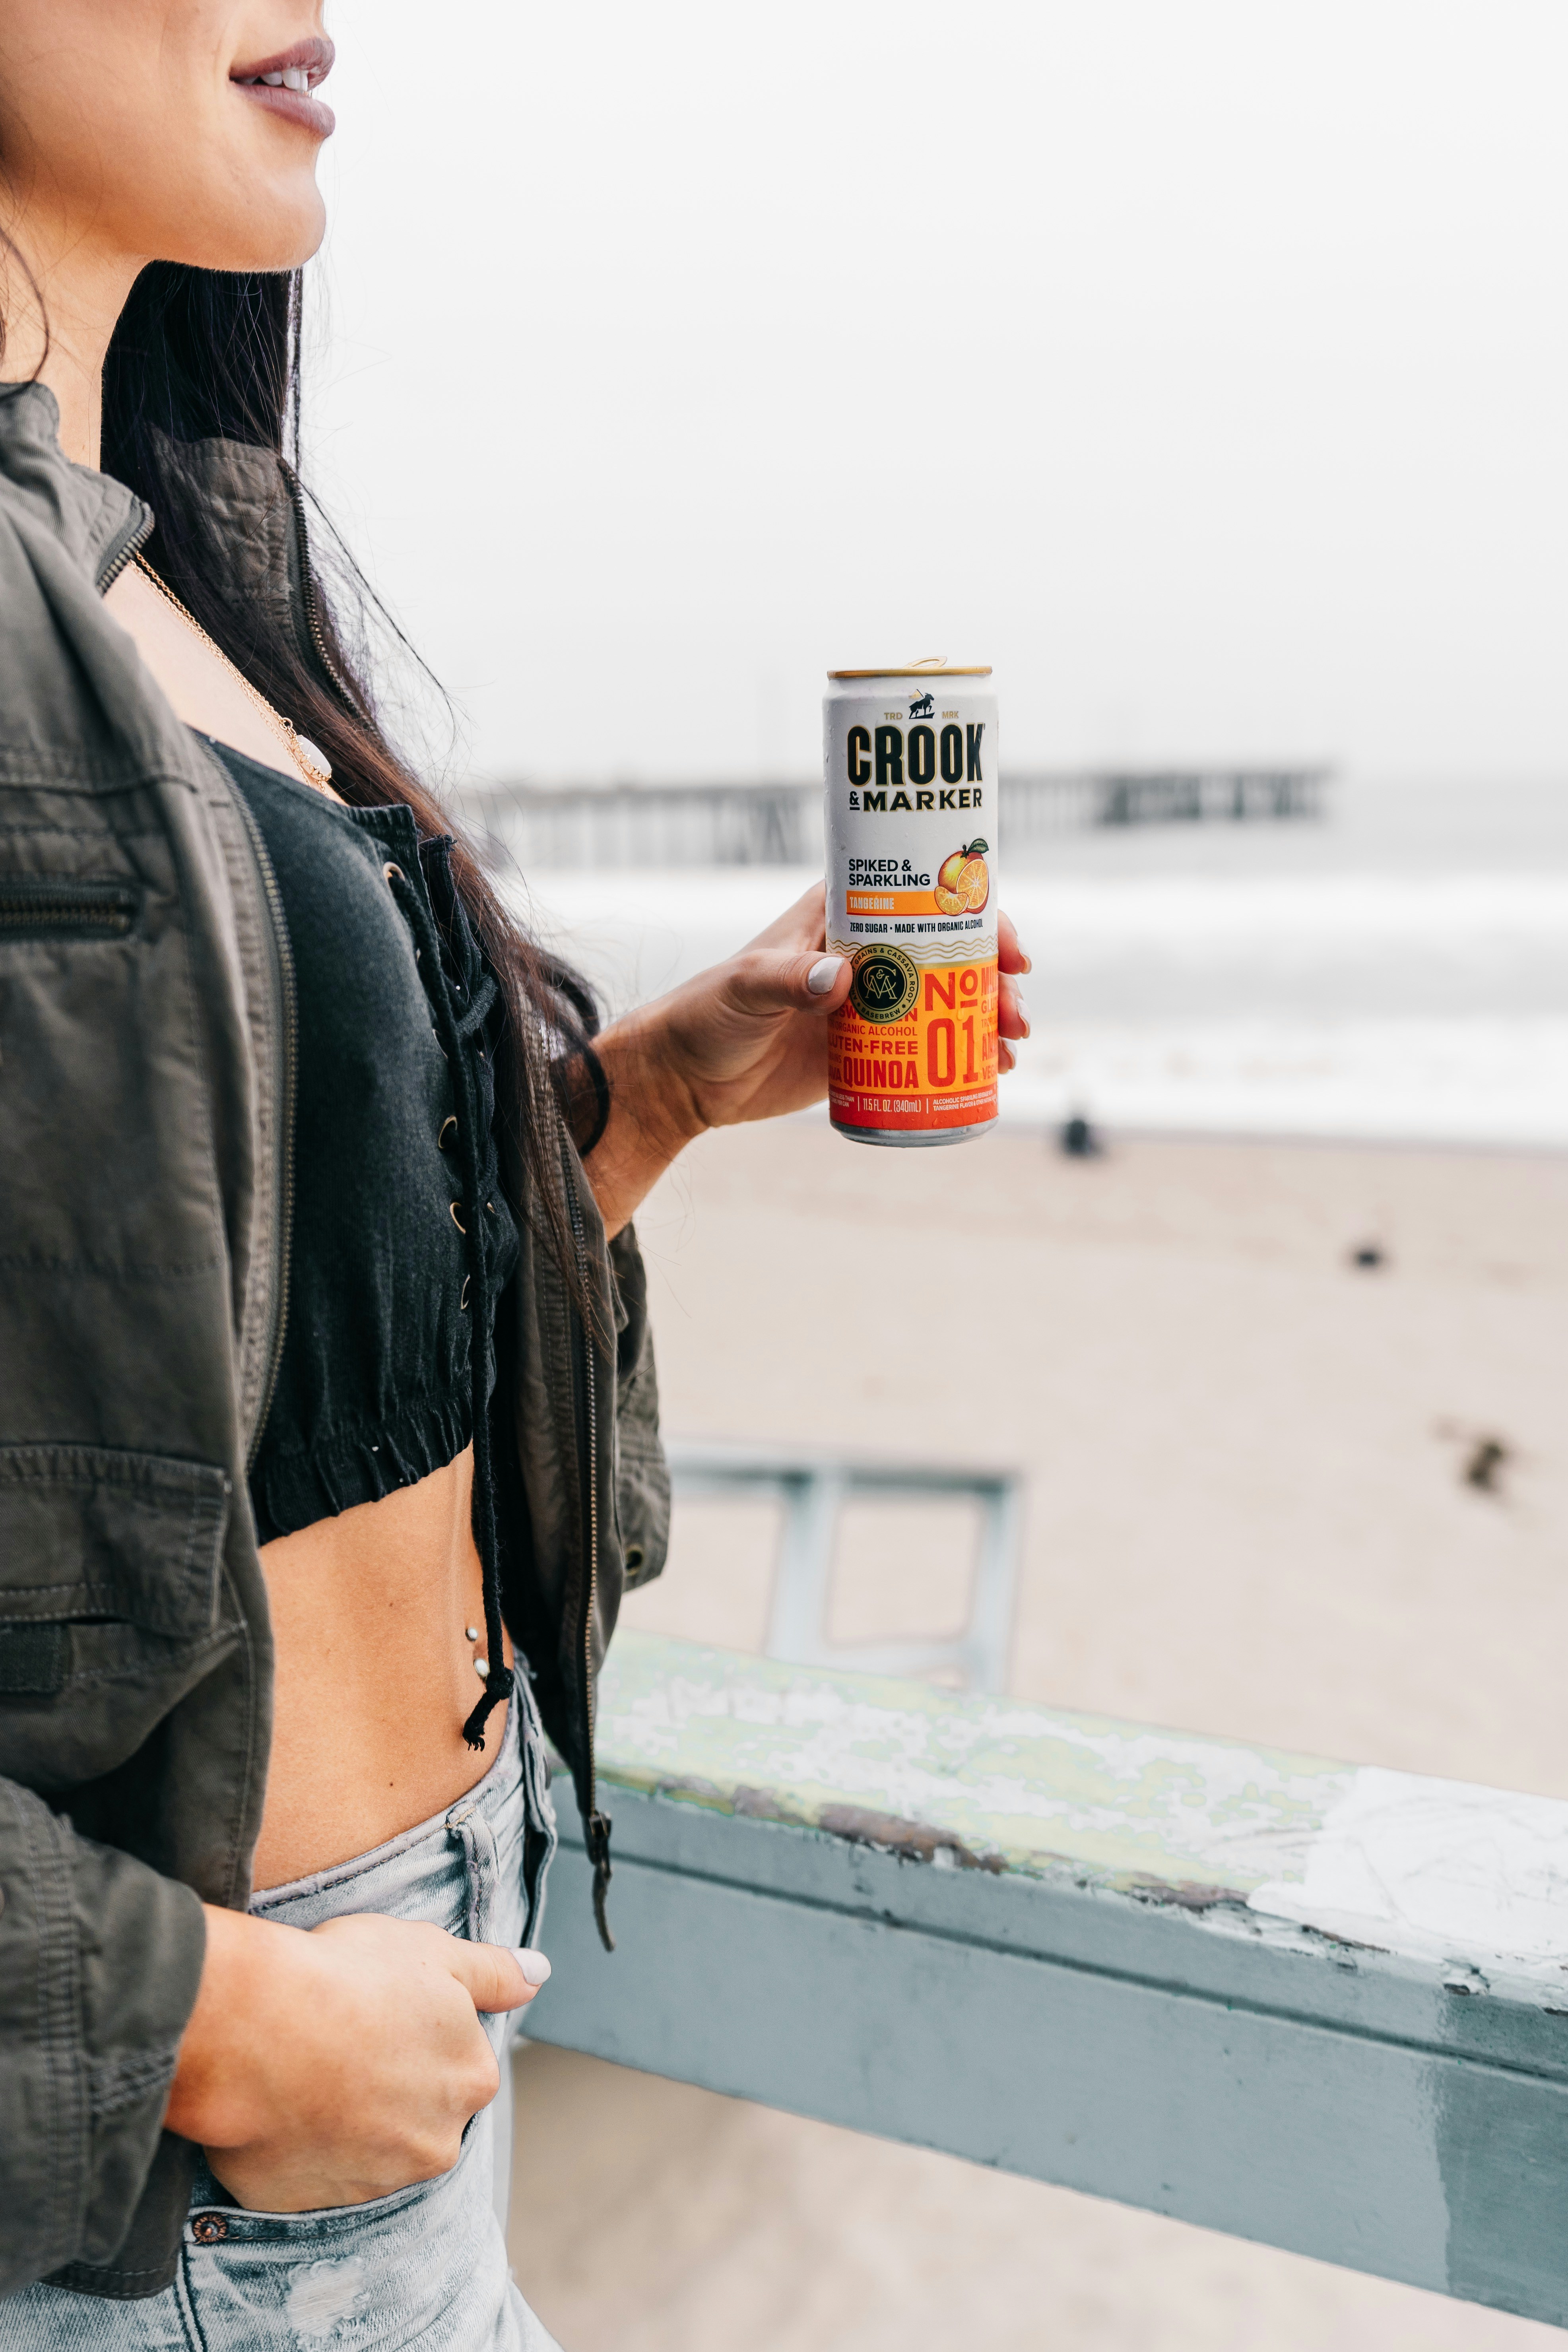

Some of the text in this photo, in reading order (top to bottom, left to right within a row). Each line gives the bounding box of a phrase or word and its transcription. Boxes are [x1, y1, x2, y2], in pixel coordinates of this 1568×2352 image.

[849, 787, 982, 812] & MARKER
[849, 859, 912, 871] SPIKED &
[849, 873, 930, 886] SPARKLING
[850, 897, 894, 910] TANGERINE
[850, 918, 983, 933] ZERO SUGAR MADE WITH ORGANIC ALCOHOL
[855, 947, 877, 964] GRAINS
[887, 949, 914, 978] CASSAVA
[906, 981, 915, 1003] ROOT
[861, 1007, 900, 1019] BASEBREW
[835, 1022, 866, 1034] ORGANIC
[868, 1026, 918, 1036] ALCOHOL
[829, 1033, 918, 1055] LUTEN-FREE
[927, 1015, 978, 1087] 01
[843, 1056, 919, 1089] QUINOA
[863, 1098, 873, 1111] 11.5
[883, 1099, 892, 1112] OZ.
[894, 1099, 921, 1112] (340mL)
[960, 1094, 978, 1102] SPARKLING
